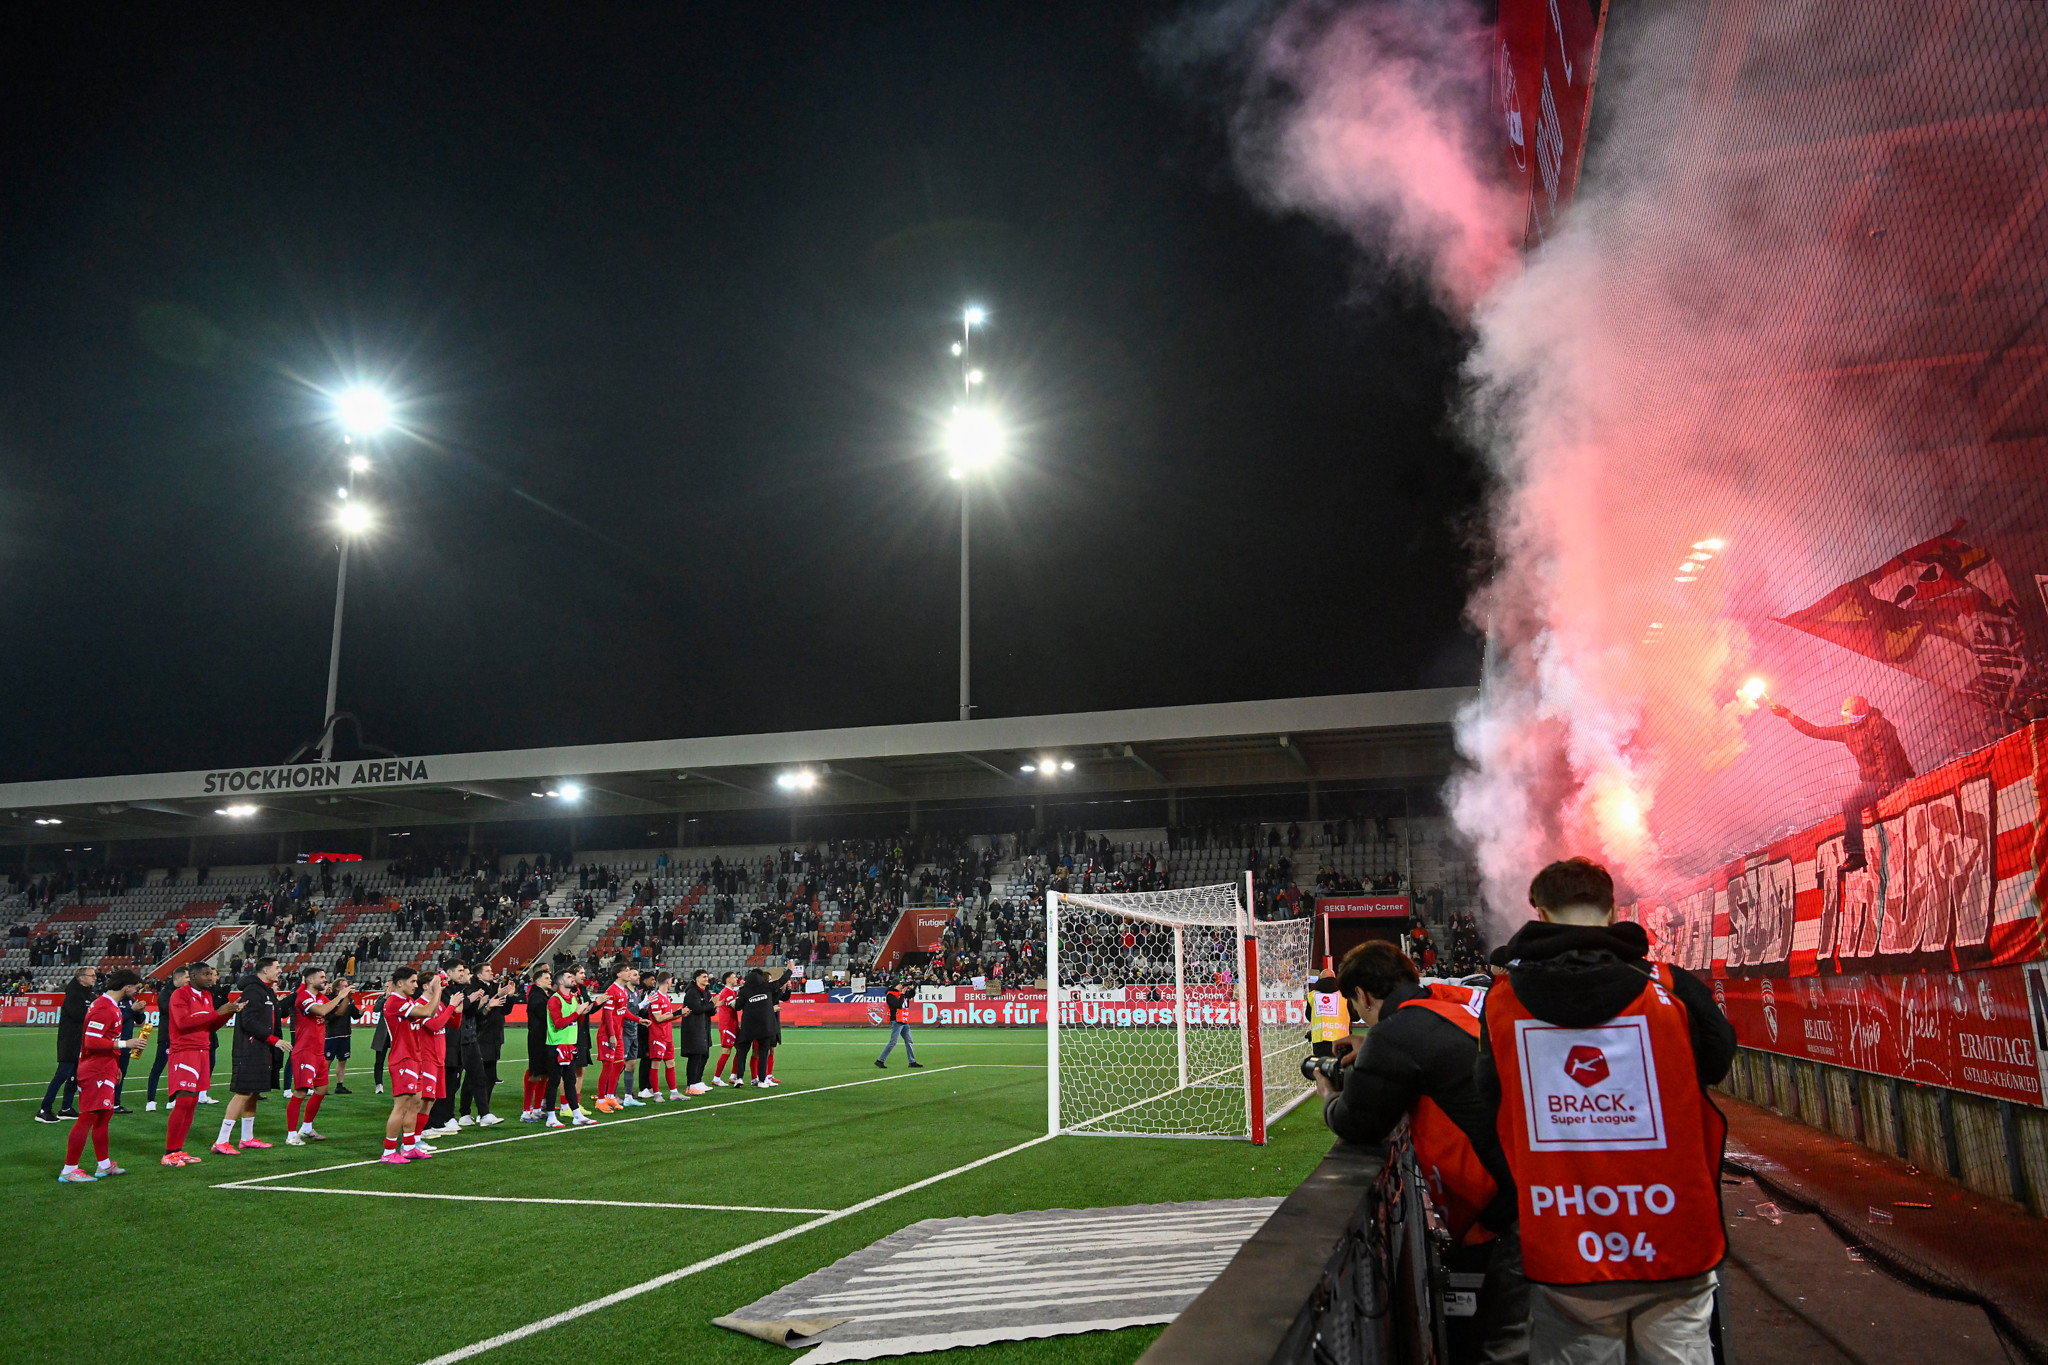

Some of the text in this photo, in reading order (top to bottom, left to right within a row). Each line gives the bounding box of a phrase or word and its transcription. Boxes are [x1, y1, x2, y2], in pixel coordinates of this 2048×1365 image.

[203, 760, 428, 793] STOCKHORN ARENA
[1815, 776, 1992, 961] THUN
[1324, 903, 1404, 912] BEKB Family Corner
[918, 918, 946, 928] Frutiger
[964, 993, 987, 1001] BEKB
[1018, 993, 1047, 1001] Corner
[1085, 992, 1112, 1000] BEKB
[1192, 992, 1224, 1000] Corner
[1265, 991, 1293, 999] BEKB
[922, 1002, 997, 1024] Danke
[1002, 1001, 1040, 1024] für
[1322, 1030, 1333, 1038] 02
[1803, 1018, 1833, 1042] BEATUS
[1959, 1032, 2035, 1068] ERMITAGE
[1963, 1066, 2039, 1093] GSTAAD-SCHÖNRIED
[1547, 1093, 1635, 1113] BRACK.
[1550, 1113, 1637, 1126] Super League
[1530, 1183, 1676, 1217] PHOTO
[1577, 1230, 1657, 1263] 094
